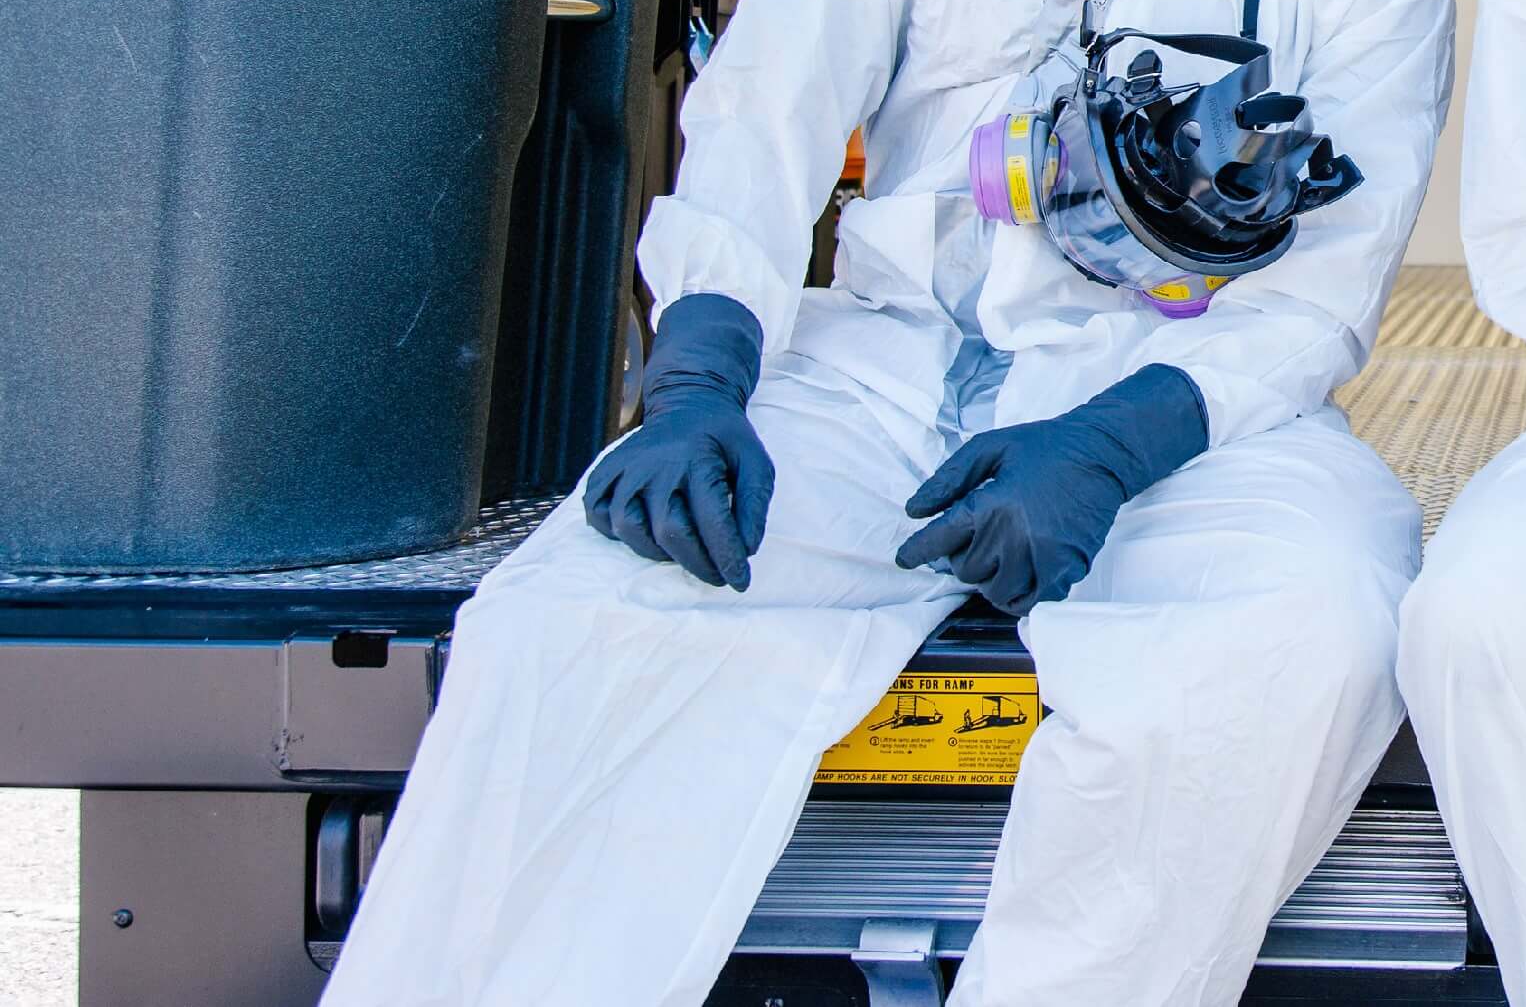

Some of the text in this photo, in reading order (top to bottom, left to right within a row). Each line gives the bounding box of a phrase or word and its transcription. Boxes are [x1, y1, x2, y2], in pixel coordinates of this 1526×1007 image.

[889, 679, 975, 690] ONS FOR RAMP
[838, 773, 867, 781] HOOKS
[870, 773, 889, 781] ARE
[912, 774, 954, 782] SECURELY
[958, 774, 966, 782] IN
[971, 774, 995, 783] HOOK
[999, 774, 1018, 783] SLO
